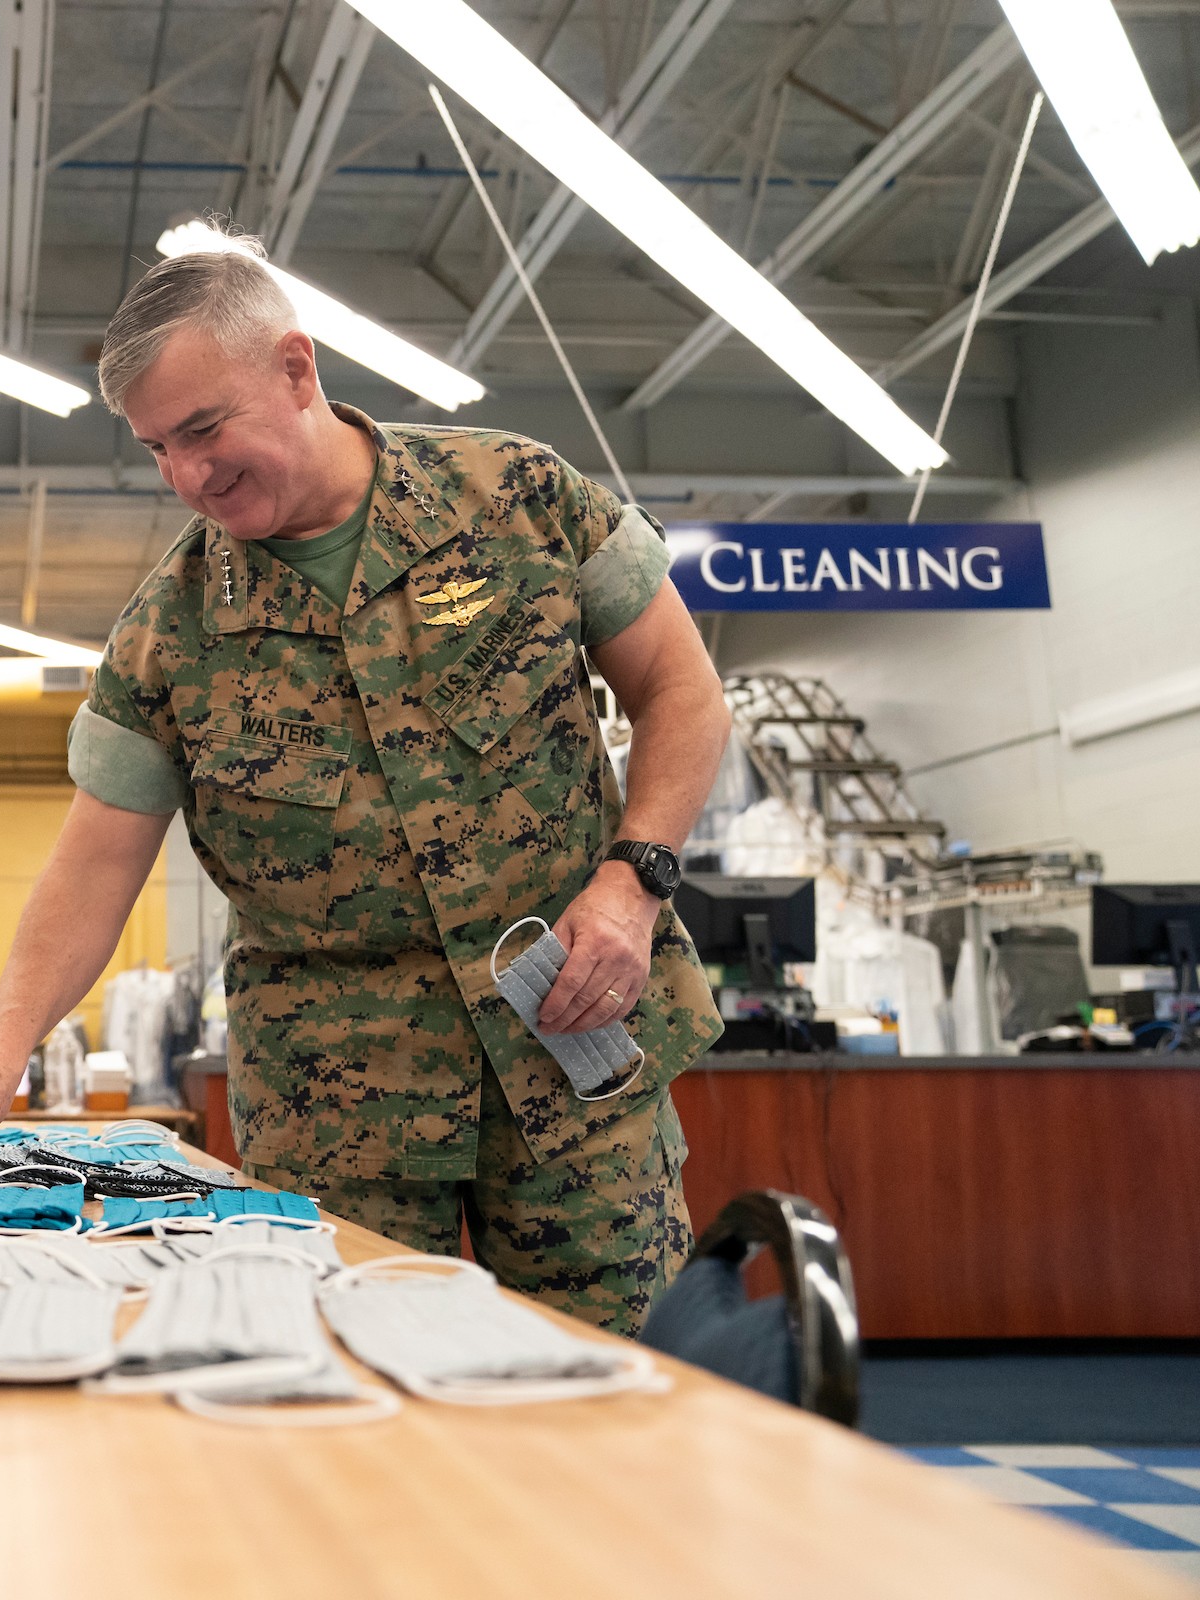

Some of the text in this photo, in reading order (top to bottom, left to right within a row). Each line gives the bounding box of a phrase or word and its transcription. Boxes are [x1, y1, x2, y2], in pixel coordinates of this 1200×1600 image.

[701, 541, 1004, 592] CLEANING
[435, 606, 525, 701] U.S. MARINES
[241, 715, 325, 747] WALTERS
